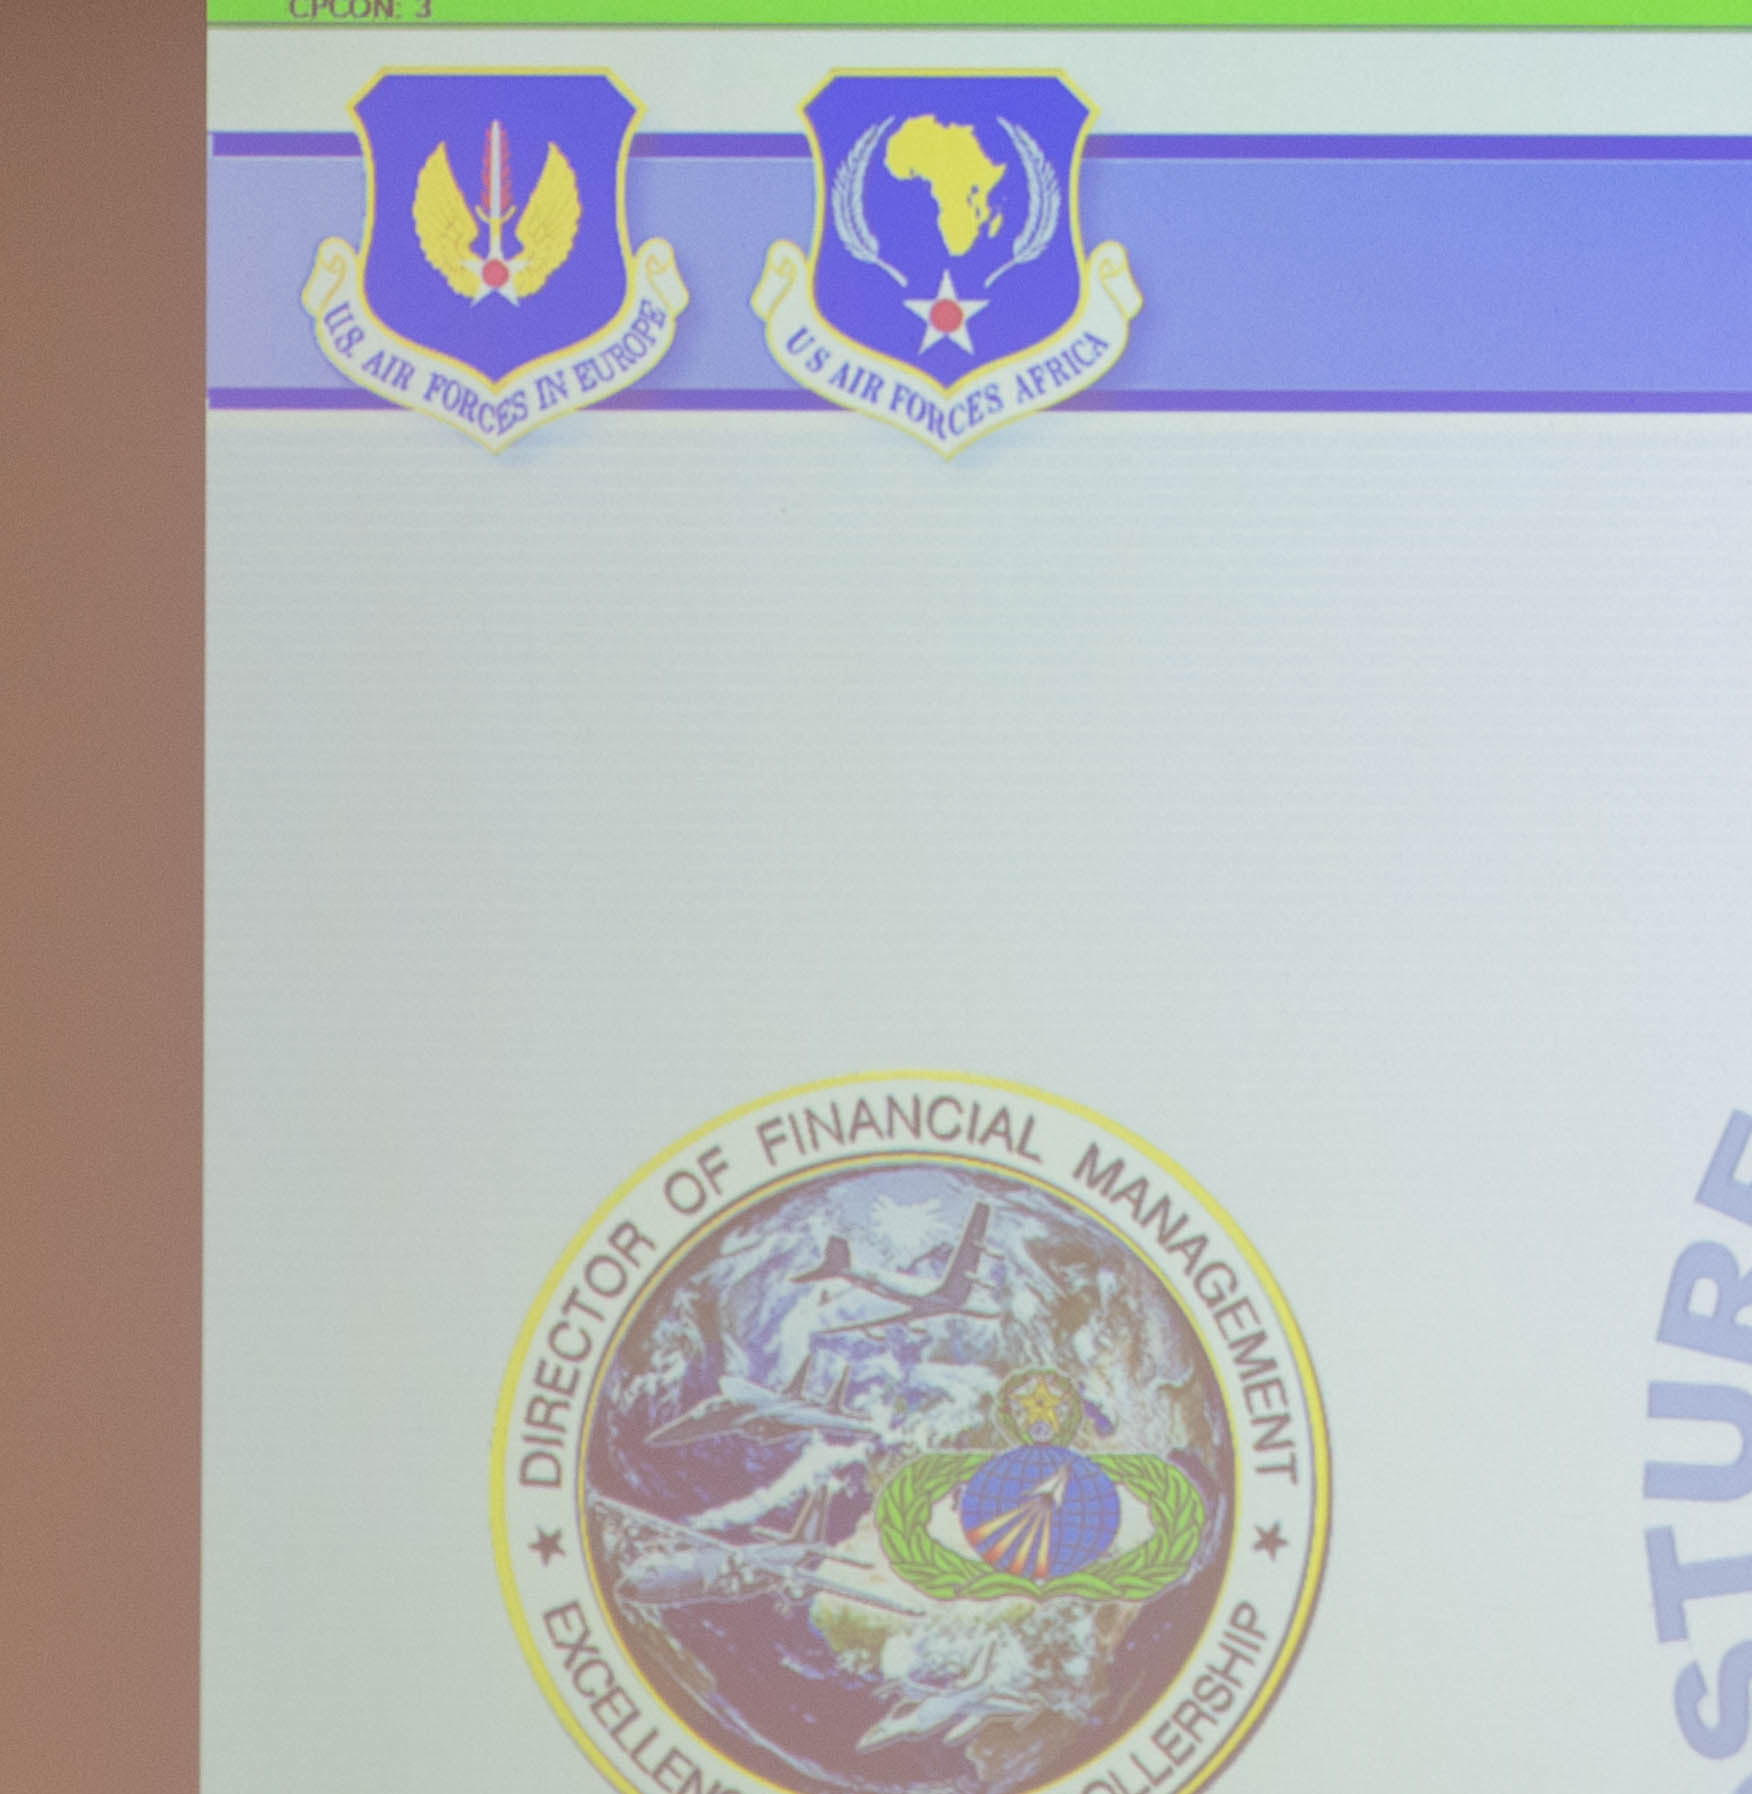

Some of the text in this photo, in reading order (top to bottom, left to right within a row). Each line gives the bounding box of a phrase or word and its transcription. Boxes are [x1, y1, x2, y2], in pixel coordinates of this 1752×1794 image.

[361, 350, 417, 392] AIR
[422, 371, 530, 437] FORCES
[534, 368, 570, 412] IN
[574, 298, 668, 394] EUROPE
[827, 360, 885, 406] AIR
[888, 380, 1005, 442] FORCES
[1014, 329, 1110, 406] AFRICA
[519, 1094, 1299, 1490] DIRECTOR OF FINANCIAL MANAGEMENT
